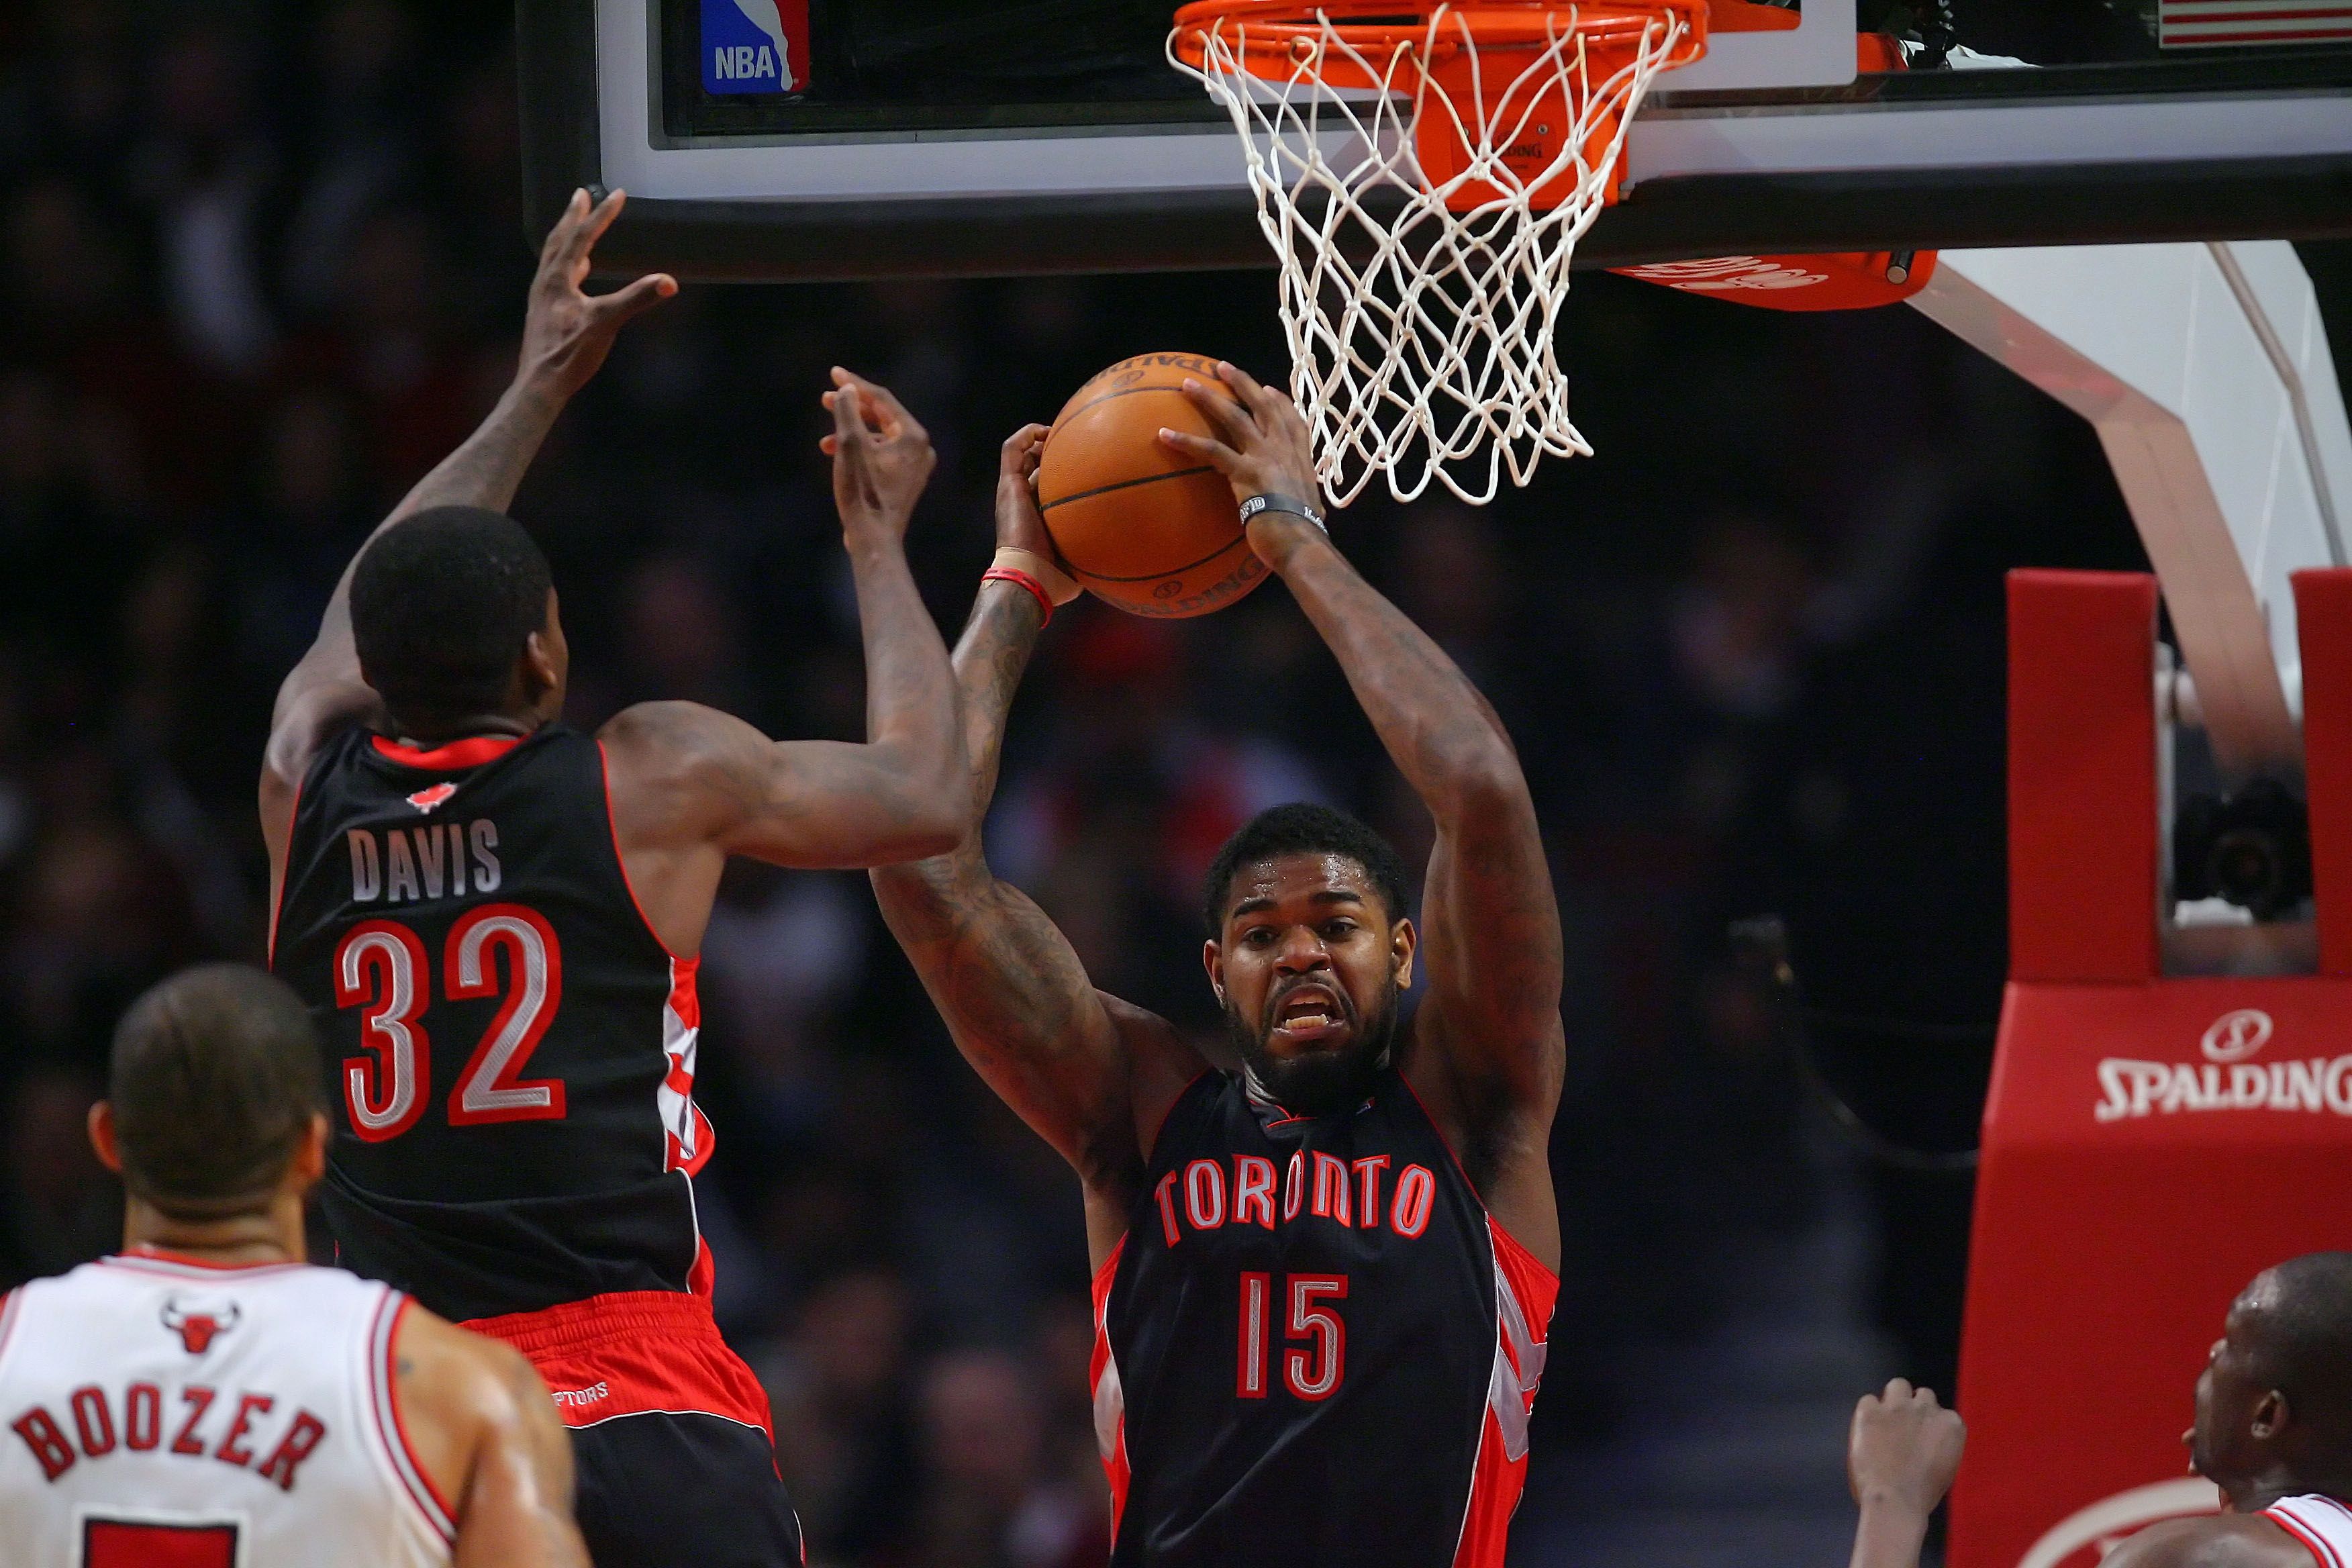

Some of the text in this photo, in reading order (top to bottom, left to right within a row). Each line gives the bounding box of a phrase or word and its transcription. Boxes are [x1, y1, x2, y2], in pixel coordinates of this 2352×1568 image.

[715, 45, 775, 80] NBA
[347, 818, 502, 902] DAVIS
[333, 903, 567, 1143] 32
[1154, 1148, 1436, 1249] TORONTO
[1236, 1271, 1349, 1402] 15
[11, 1381, 326, 1492] BOOZER
